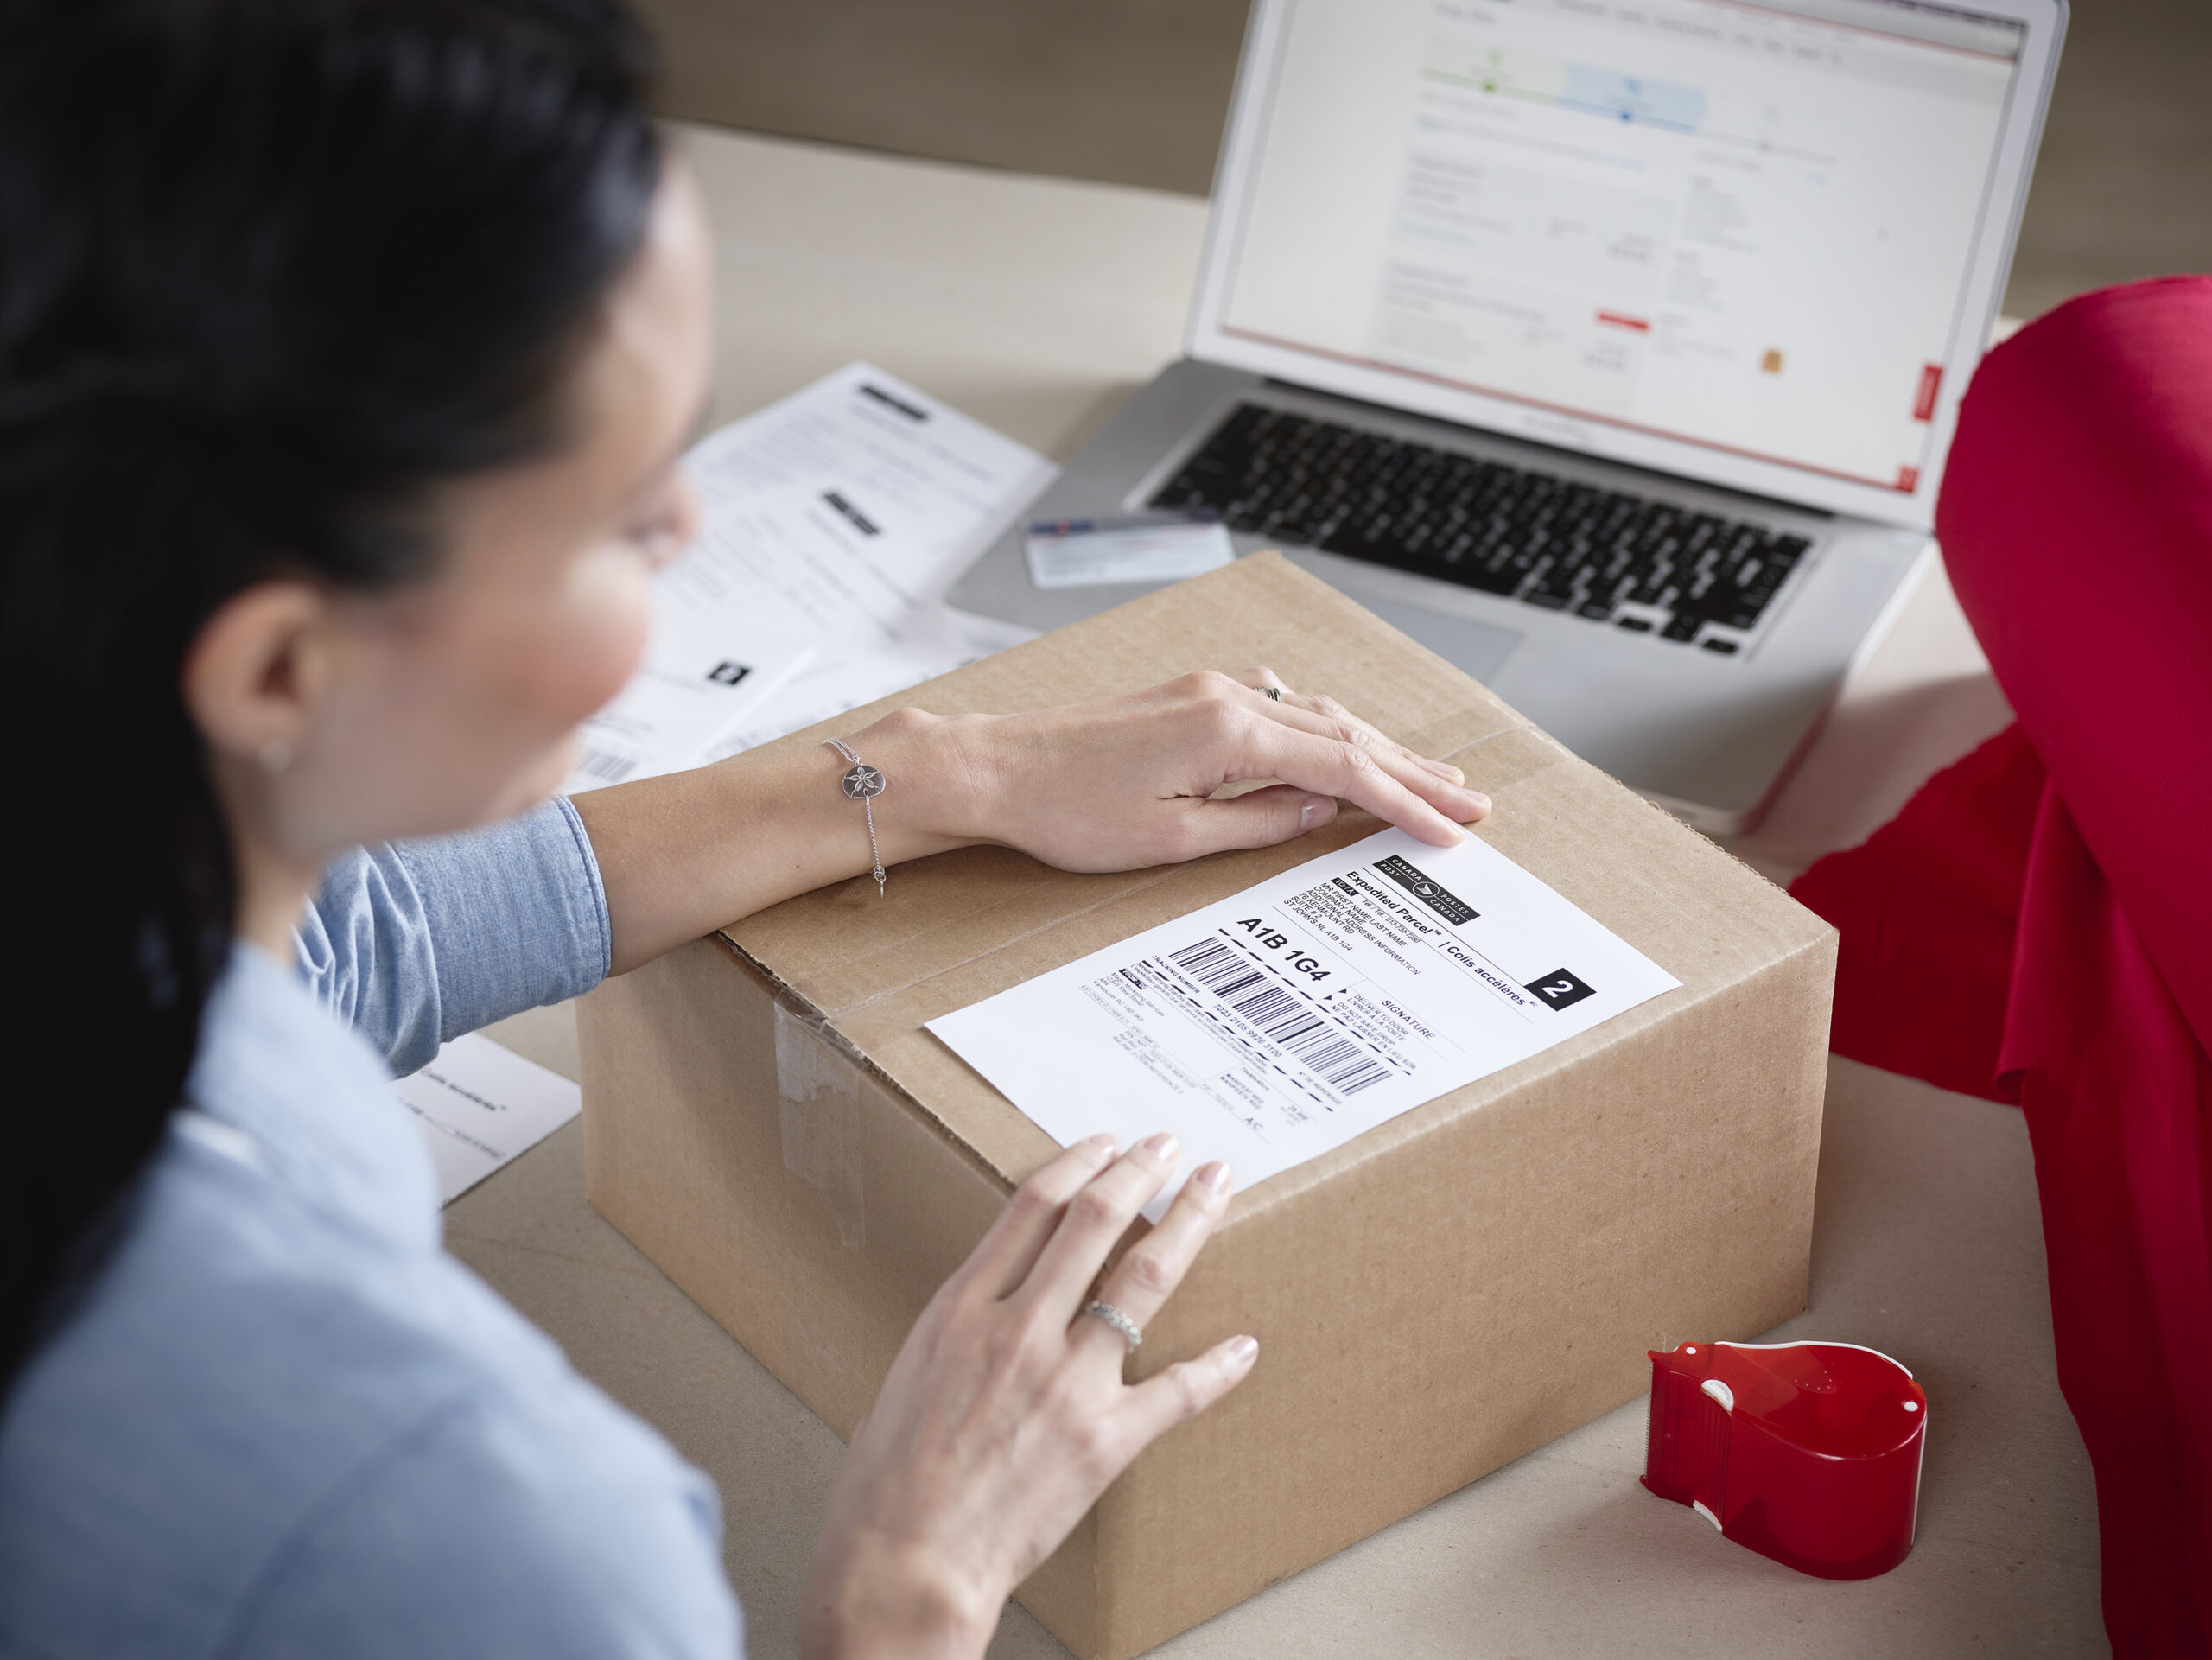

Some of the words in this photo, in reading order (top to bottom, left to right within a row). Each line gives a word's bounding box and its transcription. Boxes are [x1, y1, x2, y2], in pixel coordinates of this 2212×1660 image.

[1380, 863, 1401, 877] POST
[1392, 859, 1422, 881] CANADA
[1290, 895, 1313, 912] SUITE
[1298, 892, 1310, 900] 76
[1306, 898, 1346, 926] KENMOUNT
[1341, 925, 1355, 935] RD
[1313, 886, 1349, 910] COMPANY
[1344, 909, 1367, 925] NAME
[1320, 882, 1335, 893] MR
[1331, 890, 1354, 906] FIRST
[1350, 904, 1373, 920] NAME
[1368, 919, 1389, 932] LAST
[1385, 931, 1408, 947] NAME
[1345, 870, 1401, 910] Expedited
[1446, 945, 1476, 968] Colis
[1429, 899, 1460, 922] CANADA
[1440, 894, 1469, 914] POSTES
[1283, 899, 1296, 907] ST
[1314, 923, 1326, 932] NL
[1324, 931, 1340, 942] A1B
[1338, 940, 1353, 951] 1G4
[1305, 889, 1344, 919] ADDITIONAL
[1342, 917, 1376, 942] ADDRESS
[1373, 939, 1421, 976] INFORMATION
[1236, 918, 1288, 950] A1B
[1284, 950, 1332, 982] 1G4
[1103, 974, 1122, 989] 12345
[1127, 994, 1147, 1008] Street
[1108, 971, 1128, 985] Magic
[1121, 983, 1149, 1003] Marketing
[1143, 1000, 1168, 1018] Services
[1152, 955, 1179, 976] TRACKING
[1176, 975, 1200, 994] NUMBER
[1541, 980, 1573, 999] 2
[1213, 1003, 1232, 1018] 7023
[1229, 1016, 1249, 1031] 2105
[1246, 1029, 1266, 1045] 9926
[1262, 1043, 1283, 1058] 3100
[1337, 1002, 1350, 1010] DO
[1347, 1009, 1363, 1020] NOT
[1359, 1019, 1378, 1033] SAFE
[1376, 1031, 1396, 1046] DROP
[1339, 1012, 1355, 1023] PAS
[1351, 1021, 1380, 1042] LAISSER
[1377, 1040, 1389, 1049] EN
[1387, 1047, 1403, 1059] LIEU
[1346, 997, 1371, 1015] LIVRER
[1374, 1018, 1385, 1027] LA
[1382, 1024, 1405, 1041] PORTE
[1353, 994, 1382, 1015] DELIVER
[1380, 1014, 1391, 1022] TO
[1388, 1021, 1409, 1036] DOOR
[1381, 1000, 1435, 1039] SIGNATURE
